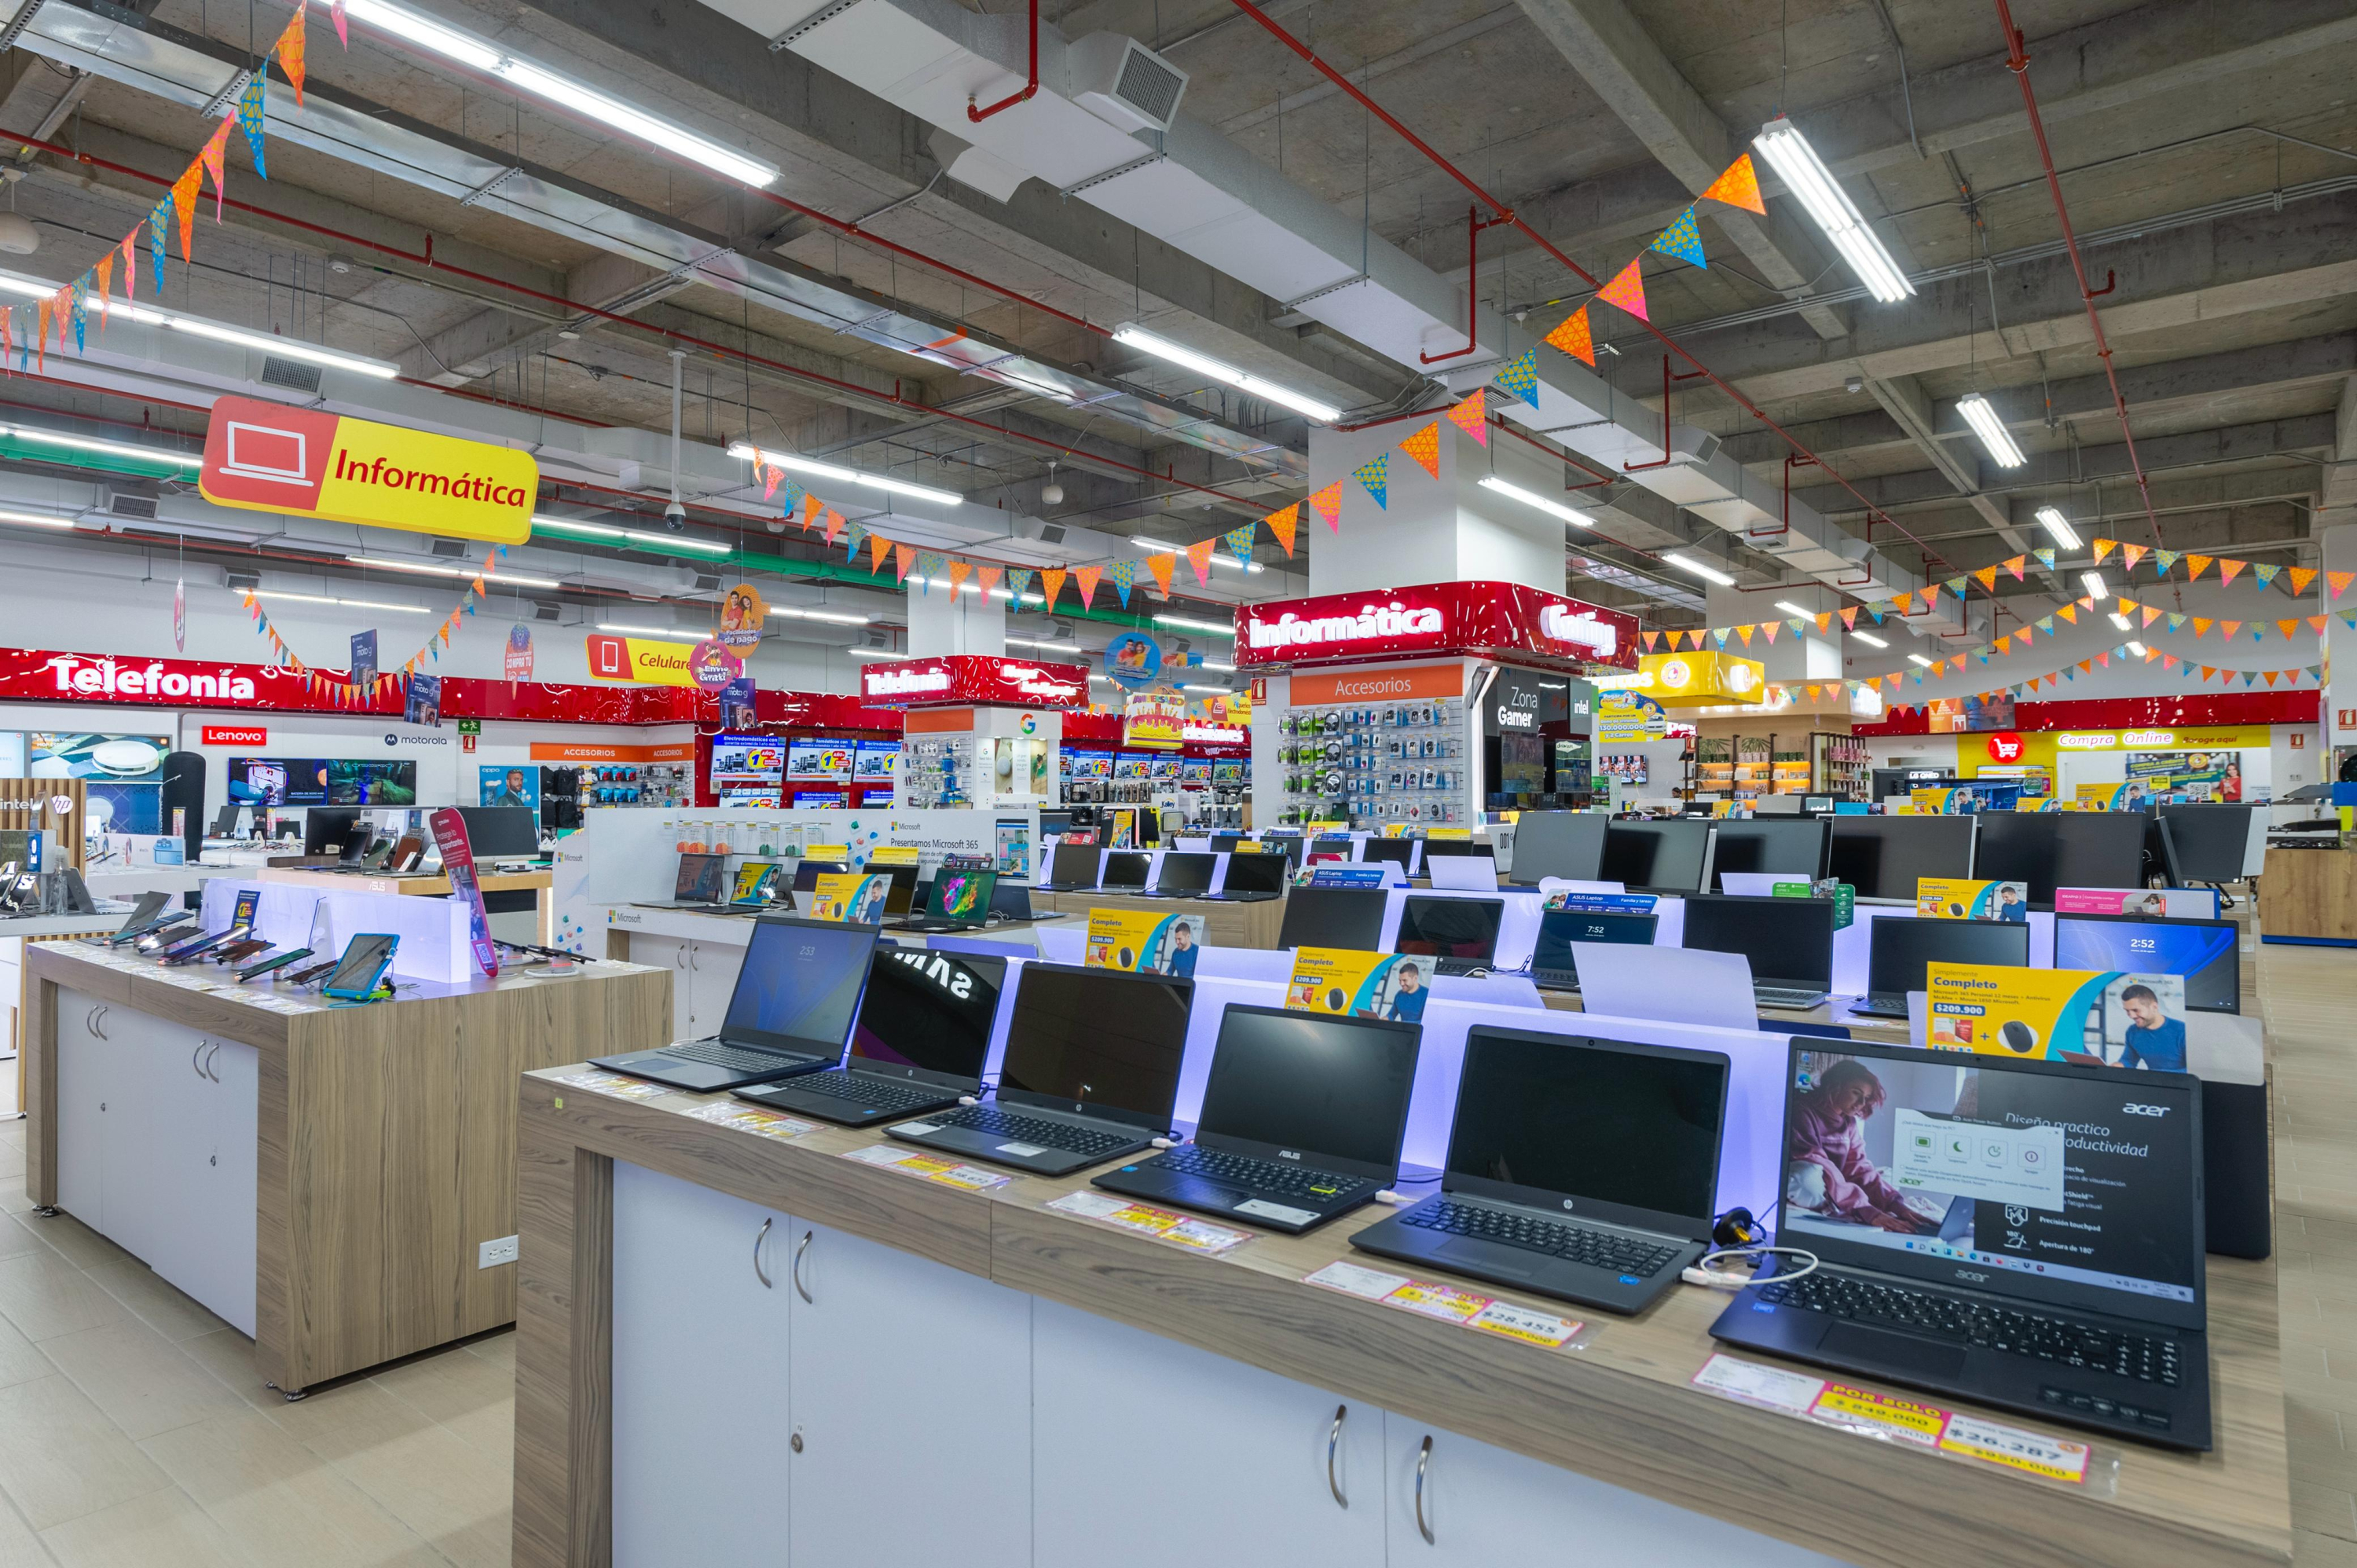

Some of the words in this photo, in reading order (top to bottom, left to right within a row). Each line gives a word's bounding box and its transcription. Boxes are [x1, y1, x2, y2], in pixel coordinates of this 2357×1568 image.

[335, 449, 526, 507] Informática
[1249, 602, 1443, 648] Informática
[736, 636, 757, 644] pago
[357, 647, 368, 657] moto
[506, 658, 524, 669] COMPRA
[639, 653, 692, 670] Celulare
[49, 659, 255, 700] Telefonía
[414, 685, 429, 694] moto
[1335, 676, 1411, 696] Accesorios
[1511, 686, 1538, 709] Zona
[1574, 699, 1589, 715] intel
[1497, 706, 1533, 727] Gamer
[208, 730, 262, 741] Lenovo
[401, 735, 447, 745] motorola
[2059, 734, 2116, 747] Compra
[2124, 732, 2173, 745] Online
[564, 749, 615, 757] ACCESORIOS
[653, 749, 683, 757] ACCESORIOS
[751, 753, 760, 766] 1
[825, 755, 832, 767] 1
[0, 798, 33, 810] intel
[891, 838, 931, 848] Presentamos
[933, 839, 965, 849] Microsoft
[966, 840, 979, 849] 365
[1500, 833, 1509, 849] 001
[369, 881, 385, 892] ASUS
[617, 914, 642, 924] Microsoft
[1091, 918, 1122, 927] Completo
[2131, 939, 2155, 948] 2:52
[799, 945, 816, 956] 2:53
[1298, 957, 1334, 966] Completo
[1934, 969, 1978, 977] Simplemente
[1934, 976, 1998, 990] Completo
[1936, 1004, 1983, 1015] $209.900
[2122, 1103, 2171, 1117] acer
[2055, 1121, 2110, 1137] practico
[2064, 1138, 2149, 1158] oductividad
[1278, 1149, 1300, 1160] ASUS
[1899, 1177, 1924, 1186] acer
[2089, 1177, 2126, 1187] visualización
[2040, 1217, 2069, 1227] Precisión
[2069, 1221, 2101, 1232] touchpad
[2040, 1240, 2069, 1251] Apertura
[2079, 1246, 2095, 1255] 180°
[1955, 1268, 1990, 1283] acer
[1832, 1383, 1878, 1403] POR
[1881, 1393, 1943, 1419] SOLO
[1949, 1426, 2062, 1462] $26.287
